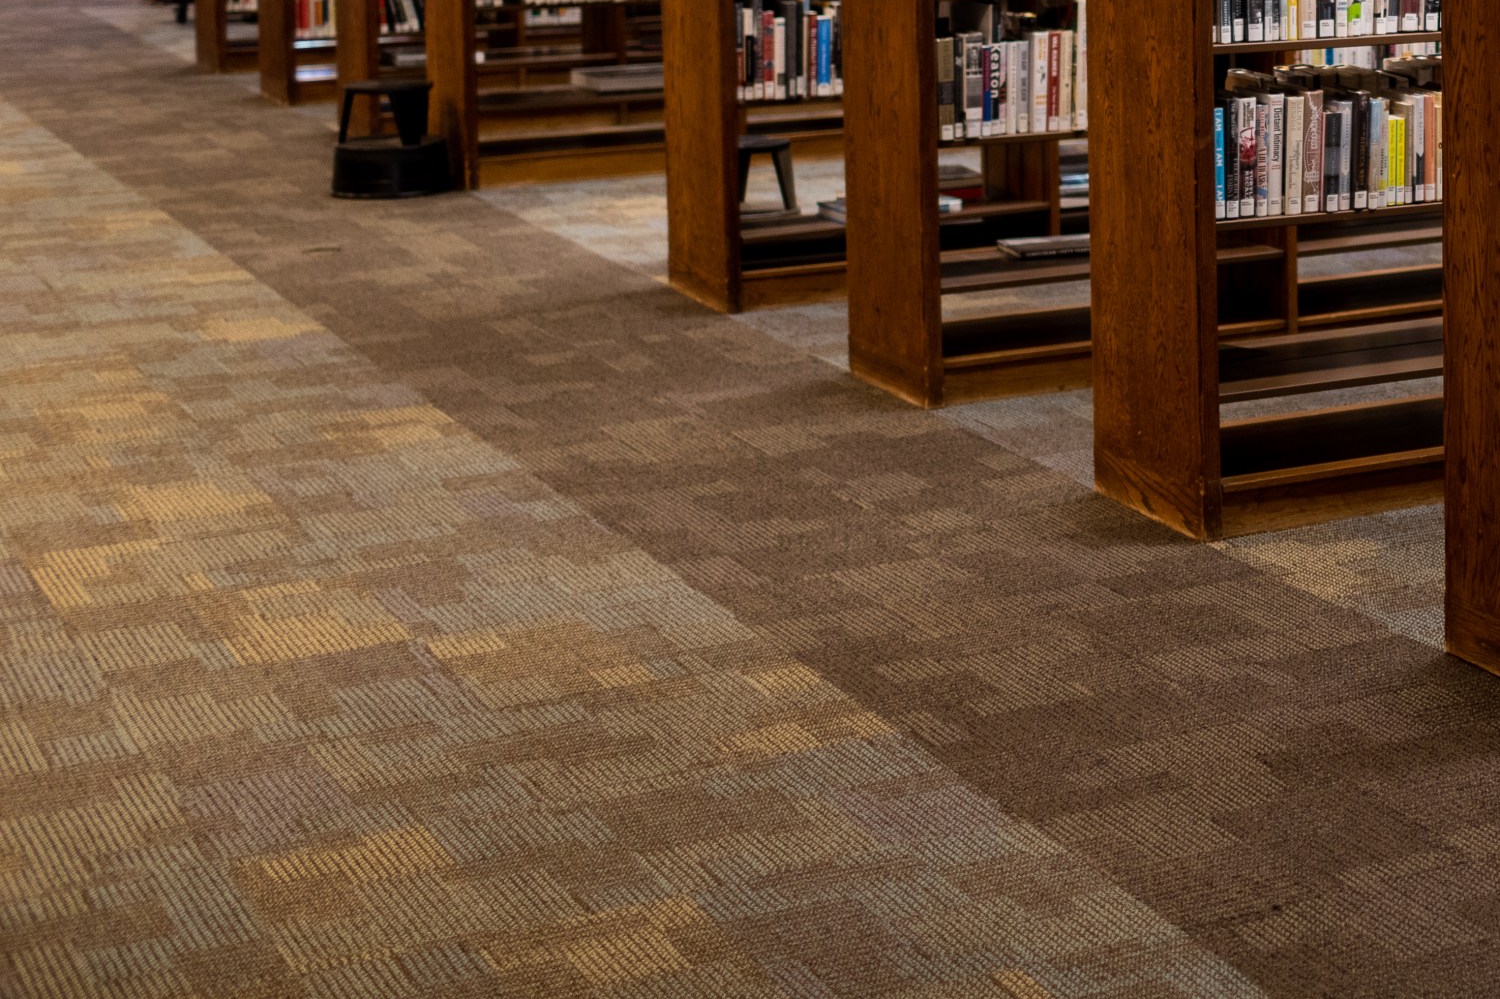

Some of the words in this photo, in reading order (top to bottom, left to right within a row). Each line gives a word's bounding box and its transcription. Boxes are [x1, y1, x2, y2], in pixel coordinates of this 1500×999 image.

[991, 43, 1001, 98] Keaton
[1273, 108, 1282, 132] Distant
[1272, 133, 1281, 162] Intimacy
